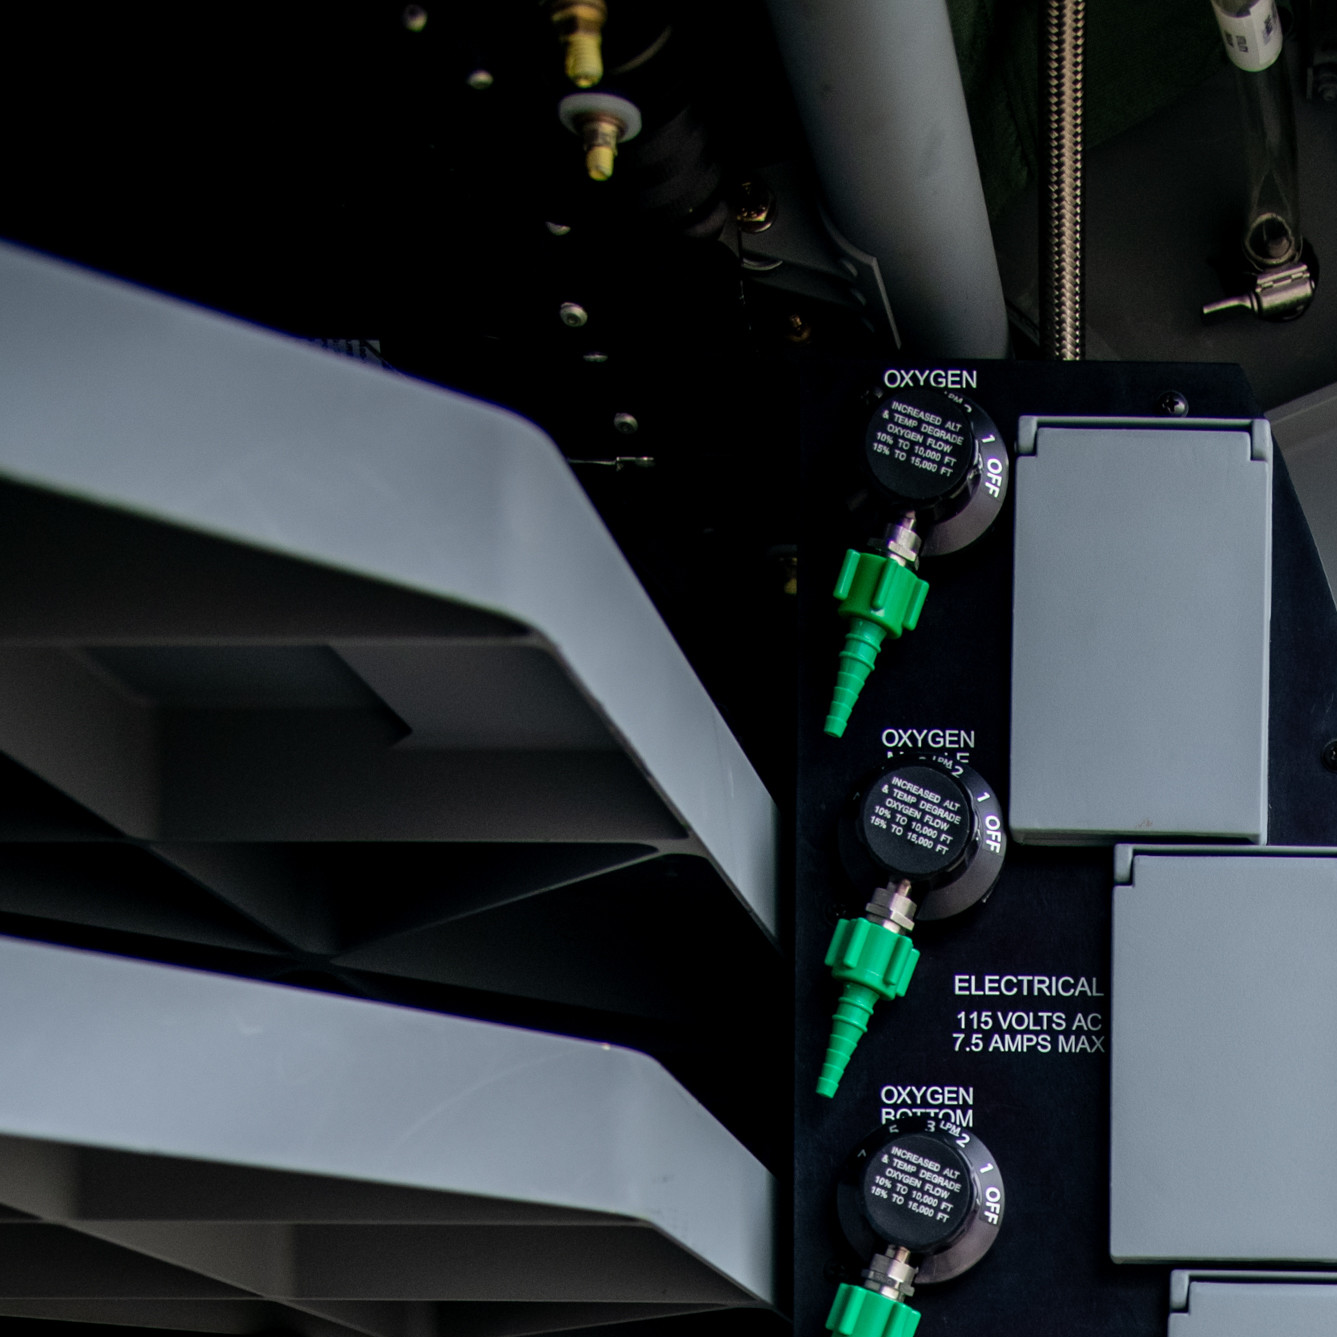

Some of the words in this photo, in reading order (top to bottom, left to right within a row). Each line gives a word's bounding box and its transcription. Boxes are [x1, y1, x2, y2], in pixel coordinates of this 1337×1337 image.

[884, 369, 977, 389] OXYGEN
[882, 410, 889, 419] &
[894, 413, 918, 428] TEMP
[921, 424, 963, 445] DEGRADE
[891, 401, 942, 426] INCREASED
[945, 421, 962, 432] ALT
[876, 432, 893, 445] 10%
[898, 439, 910, 450] TO
[914, 446, 941, 462] 10,000
[944, 456, 957, 467] FT
[887, 424, 923, 444] OXYGEN
[927, 438, 953, 453] FLOW
[982, 435, 996, 444] 1
[873, 442, 890, 455] 15%
[895, 449, 907, 461] TO
[911, 456, 938, 472] 15,000
[941, 467, 953, 477] FT
[985, 458, 1002, 498] OFF
[881, 728, 975, 748] OXYGEN
[952, 765, 964, 778] 2
[882, 785, 889, 793] &
[893, 789, 917, 804] TEMP
[919, 802, 961, 824] DEGRADE
[892, 777, 941, 804] INCREASED
[944, 800, 960, 811] ALT
[977, 792, 990, 802] 1
[874, 806, 892, 819] 10%
[896, 815, 907, 825] TO
[911, 822, 937, 838] 10,000
[941, 834, 952, 844] FT
[886, 798, 922, 819] OXYGEN
[924, 815, 949, 831] FLOW
[870, 816, 887, 829] 15%
[892, 825, 903, 836] TO
[907, 832, 933, 849] 15,000
[936, 844, 949, 855] FT
[985, 816, 1001, 853] OFF
[954, 975, 1105, 997] ELECTRICAL
[957, 1011, 993, 1030] 115
[997, 1011, 1066, 1031] VOLTS
[1071, 1012, 1102, 1031] AC
[952, 1033, 984, 1052] 7.5
[988, 1033, 1052, 1053] AMPS
[1058, 1034, 1105, 1053] MAX
[880, 1085, 974, 1105] OXYGEN
[939, 1121, 960, 1136] LPM
[956, 1133, 970, 1147] 2
[882, 1155, 888, 1163] &
[893, 1158, 917, 1173] TEMP
[919, 1170, 961, 1192] DEGRADE
[891, 1146, 941, 1172] INCREASED
[944, 1168, 960, 1179] ALT
[980, 1163, 993, 1173] 1
[875, 1176, 892, 1188] 10%
[896, 1184, 908, 1194] TO
[912, 1191, 938, 1207] 10,000
[941, 1202, 953, 1212] FT
[885, 1168, 922, 1188] OXYGEN
[925, 1183, 950, 1199] FLOW
[871, 1186, 888, 1199] 15%
[892, 1194, 904, 1205] TO
[908, 1201, 934, 1217] 15,000
[937, 1212, 950, 1222] FT
[984, 1187, 1000, 1225] OFF
